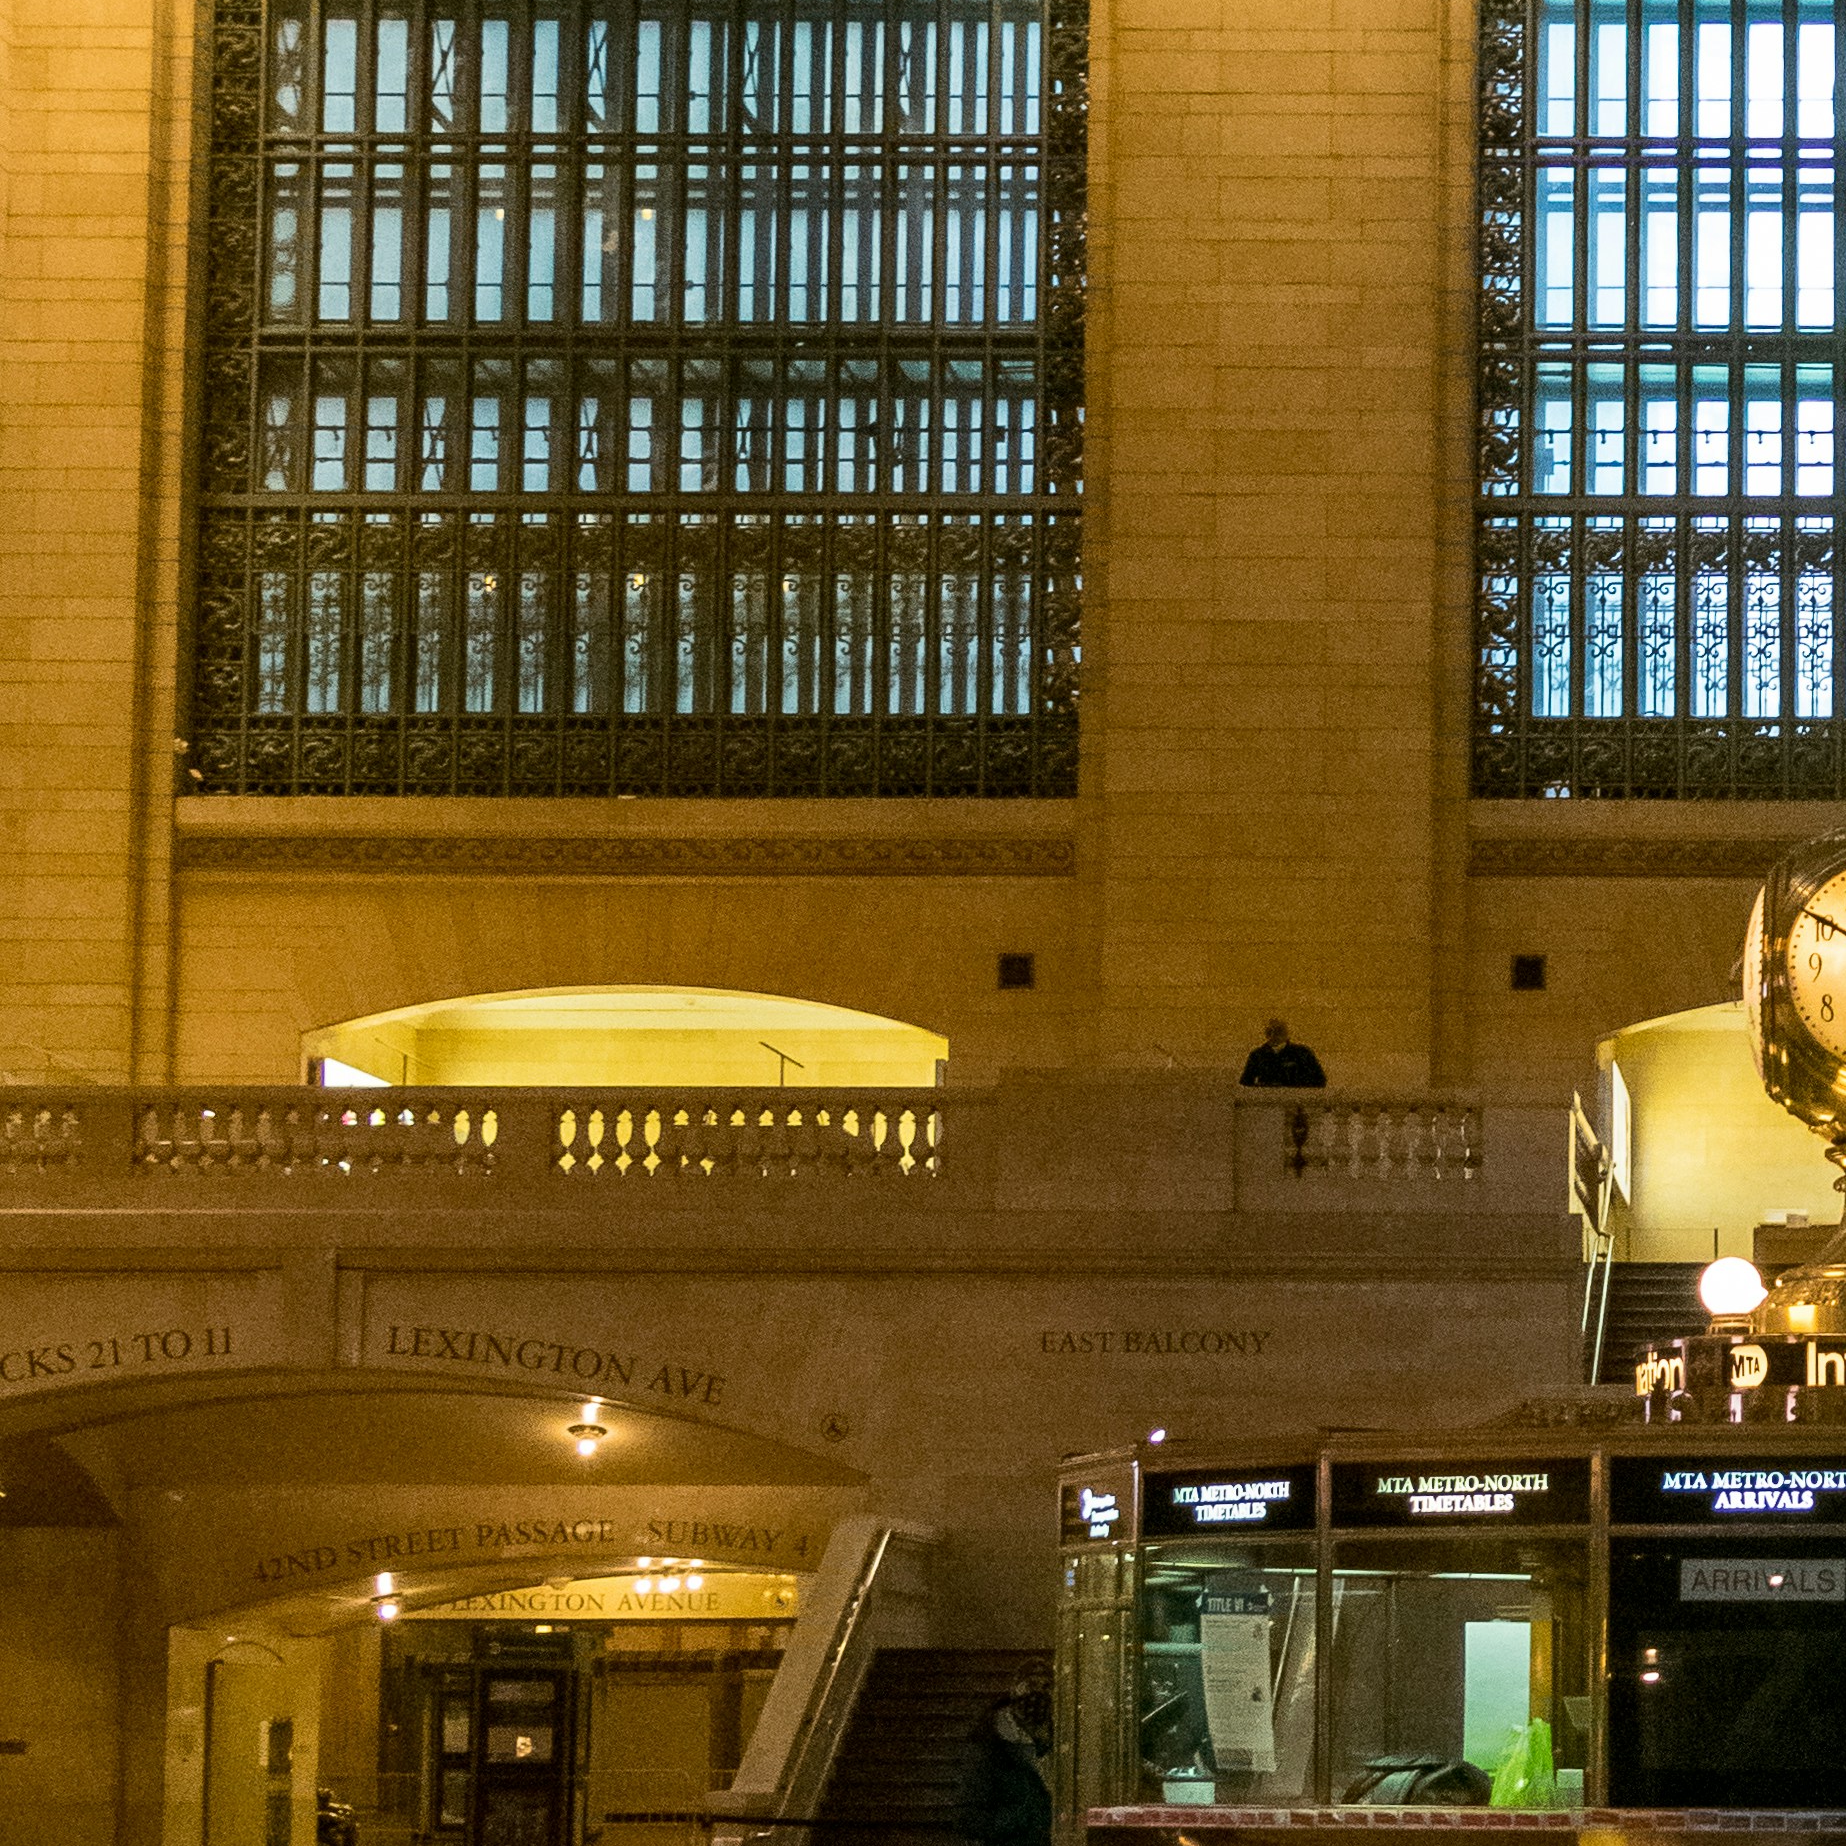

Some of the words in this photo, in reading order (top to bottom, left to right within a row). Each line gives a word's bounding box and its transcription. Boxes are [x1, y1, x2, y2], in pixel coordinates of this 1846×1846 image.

[1815, 914, 1834, 943] 10
[1808, 952, 1822, 983] 9
[1820, 994, 1834, 1022] 8
[86, 1337, 119, 1369] 21
[133, 1328, 192, 1362] TO
[1041, 1331, 1114, 1353] EAST
[1122, 1331, 1272, 1353] BALCONY
[386, 1326, 637, 1386] LEXINGTON
[648, 1364, 729, 1406] AVE
[1173, 1486, 1199, 1503] MTA
[1201, 1481, 1291, 1502] METRO-NORTH
[1376, 1477, 1414, 1494] MTA
[1418, 1474, 1549, 1492] METRO-NORTH
[1663, 1473, 1706, 1489] MTA
[1410, 1494, 1514, 1513] TIMETABLES
[1715, 1491, 1814, 1510] ARRIVALS
[1195, 1502, 1267, 1522] TIMETABLES
[348, 1527, 463, 1565] STREET
[476, 1519, 614, 1548] PASSAGE
[647, 1519, 782, 1551] SUBWAY
[1692, 1569, 1835, 1592] ARRIVALS
[618, 1593, 719, 1613] AVENUE
